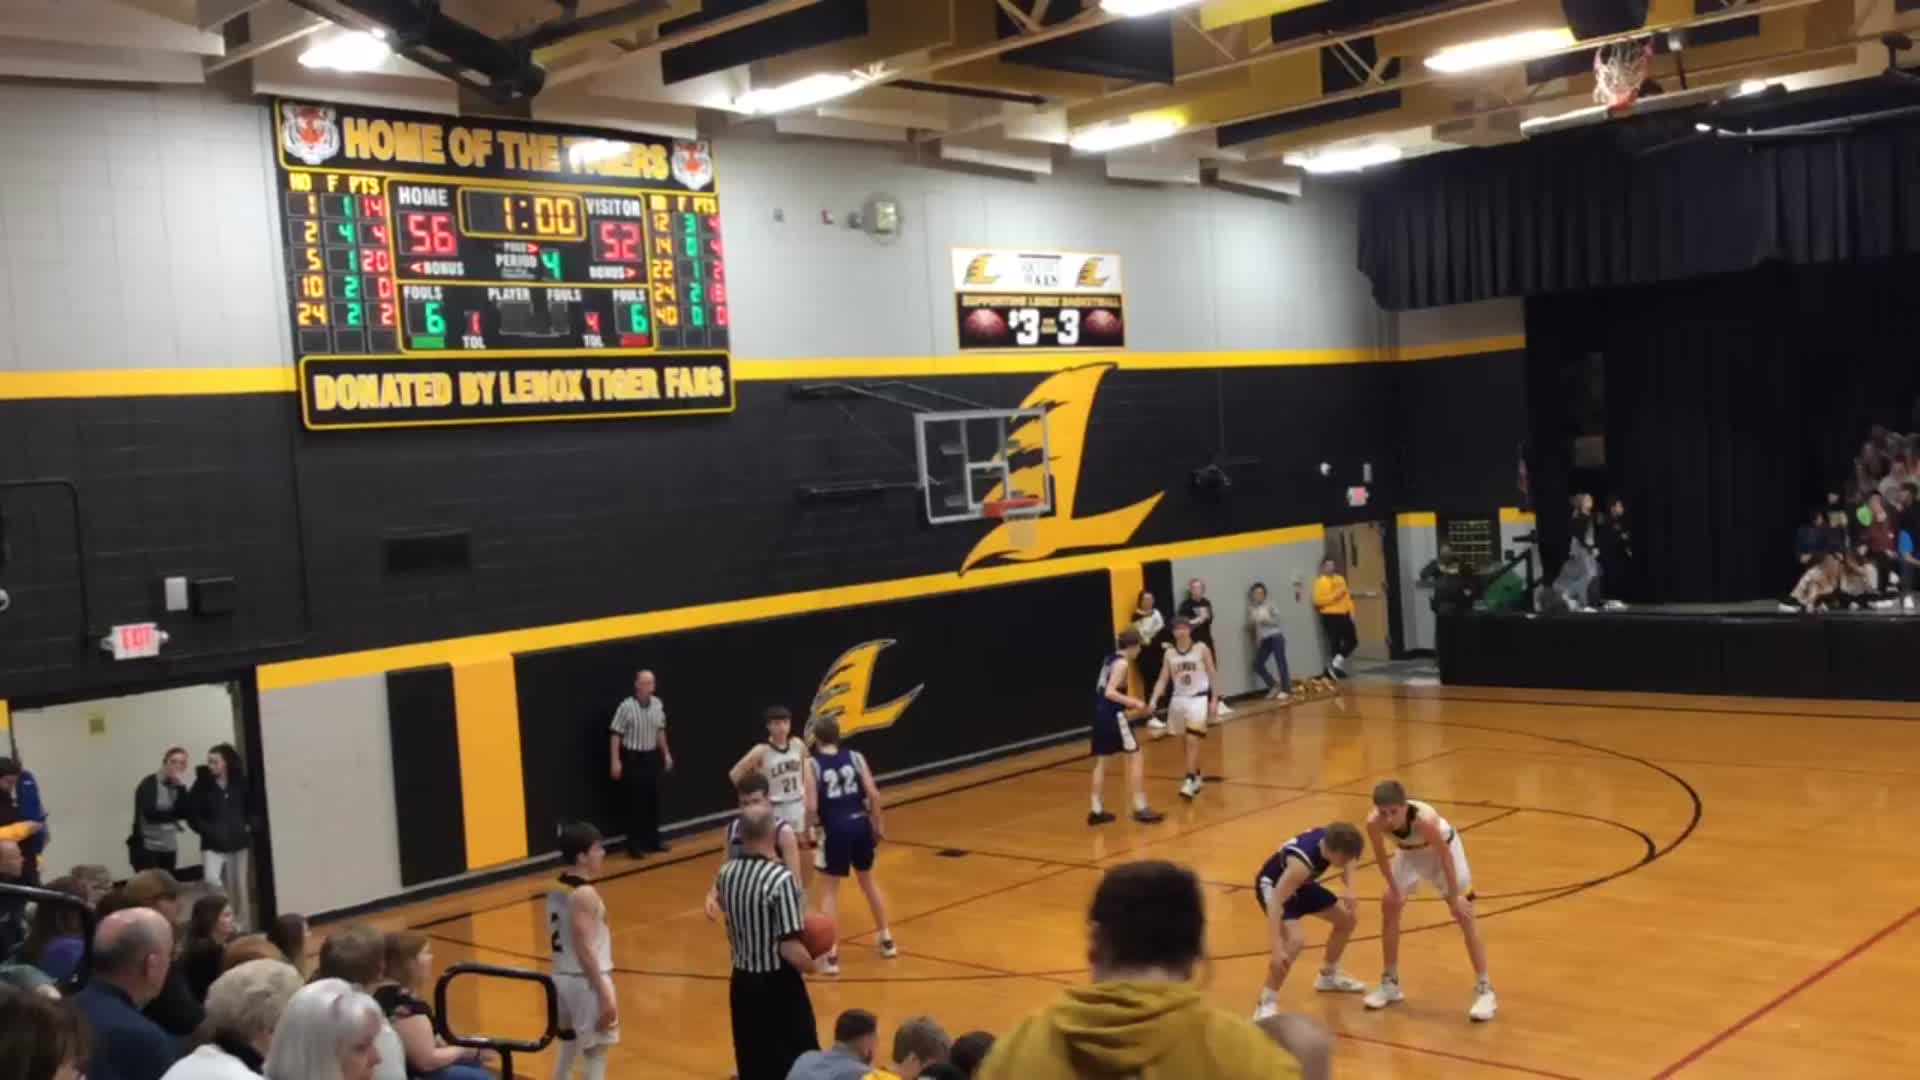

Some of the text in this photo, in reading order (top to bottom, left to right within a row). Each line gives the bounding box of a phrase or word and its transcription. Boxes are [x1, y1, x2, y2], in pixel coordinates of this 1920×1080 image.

[343, 117, 670, 181] HOME OF THE TERS
[289, 173, 380, 195] NO F PTS
[307, 195, 384, 217] 1 1 14
[398, 186, 449, 207] HOME
[585, 197, 640, 217] VISITOR
[503, 196, 577, 234] 1:00
[653, 213, 670, 232] 12
[304, 221, 387, 245] 2 4 4
[407, 213, 455, 253] 56
[601, 222, 640, 260] 52
[656, 237, 672, 255] 14
[306, 248, 389, 271] 5 1 20
[541, 251, 562, 280] 4
[653, 260, 673, 279] 22
[302, 275, 393, 298] 10 2 0
[403, 286, 443, 300] FOULS
[487, 287, 531, 301] PLAYER
[546, 288, 582, 302] FOULS
[612, 288, 646, 302] FOULS
[655, 283, 676, 303] 24
[689, 282, 703, 303] 2
[298, 302, 395, 326] 24 2 2
[425, 302, 447, 334] 6
[631, 303, 649, 334] 6
[1056, 309, 1080, 345] 3
[462, 335, 487, 349] TOL
[314, 366, 724, 411] DONATED BY LENOX TIGER FANS
[823, 764, 859, 799] 22
